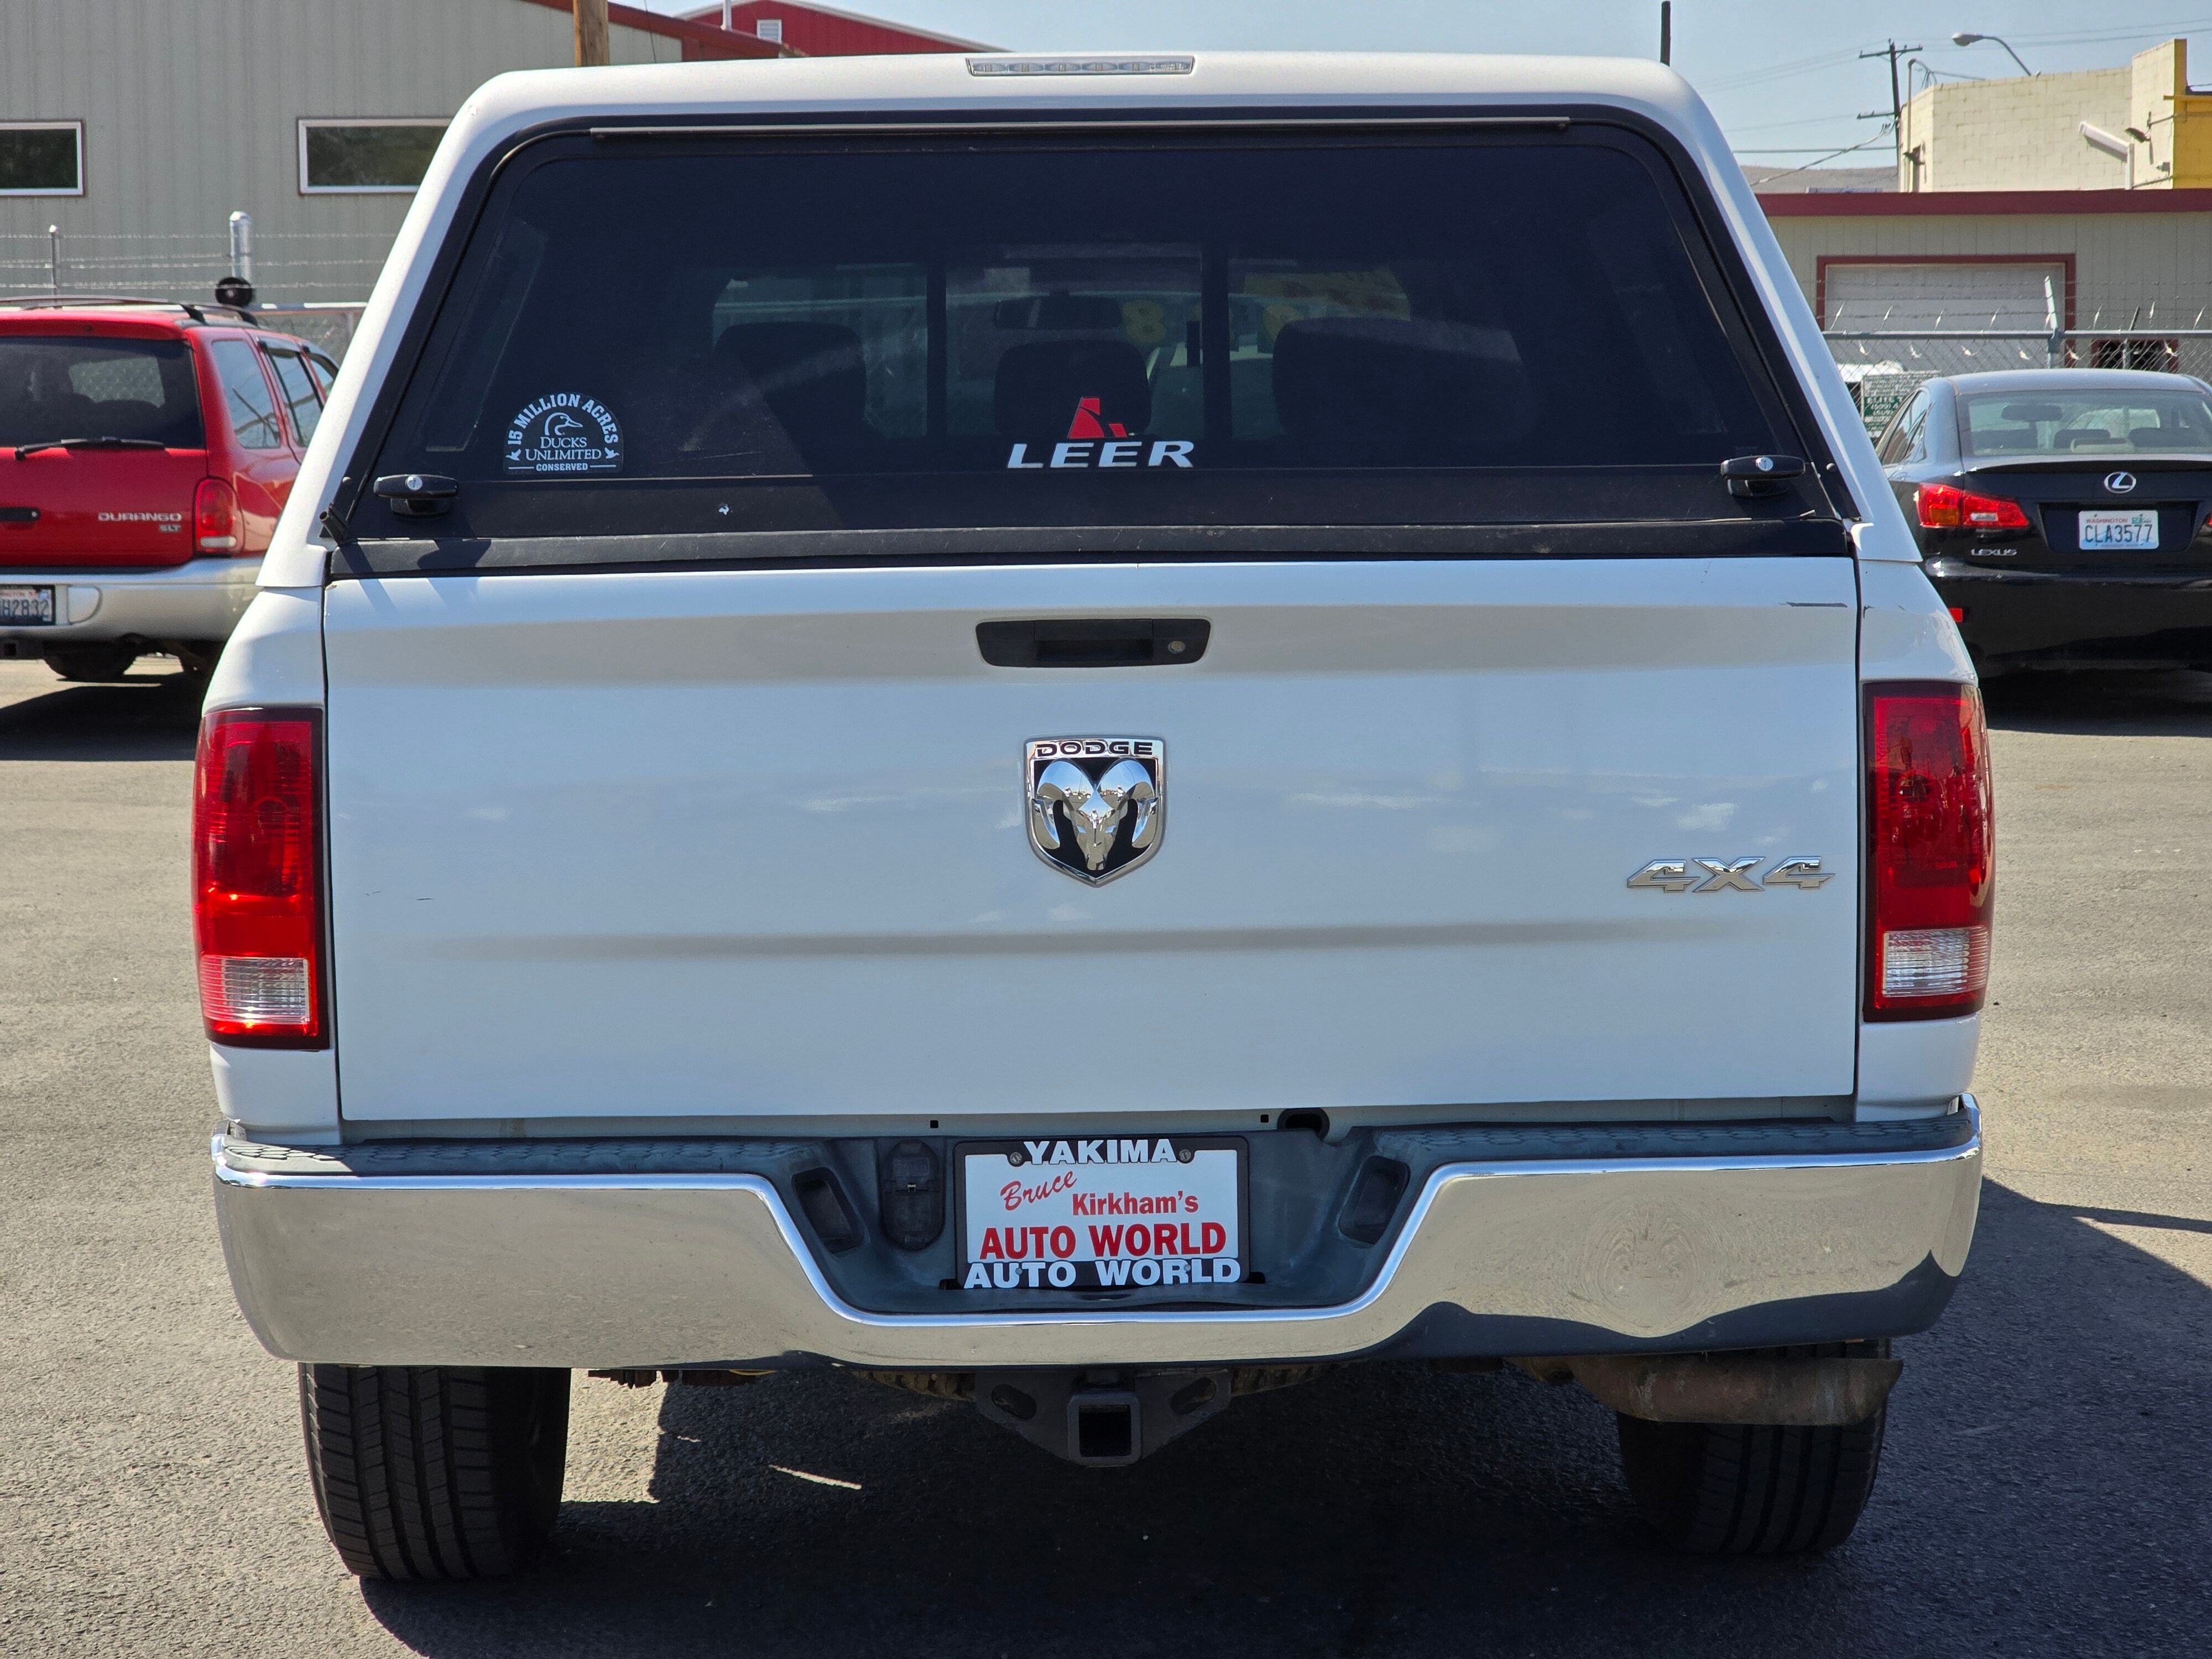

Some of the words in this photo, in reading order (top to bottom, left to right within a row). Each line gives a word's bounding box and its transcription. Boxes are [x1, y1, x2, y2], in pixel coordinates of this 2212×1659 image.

[514, 393, 581, 429] MILLION
[582, 399, 618, 444] ACRES
[508, 430, 523, 445] 15
[540, 437, 587, 448] DUCKS
[525, 448, 602, 461] UNLIMITED
[1008, 441, 1194, 469] LEER
[536, 463, 588, 472] CONSERVED
[97, 512, 182, 521] DURANGO
[2085, 524, 2153, 543] CLA3577
[0, 599, 49, 618] H2832
[1036, 741, 1153, 757] DODGE
[1626, 856, 1836, 893] 4X4
[1023, 1138, 1177, 1165] YAKIMA
[1000, 1171, 1077, 1211] Bruce
[1072, 1191, 1199, 1215] Kirkham's
[979, 1225, 1076, 1260] AUTO
[1088, 1222, 1227, 1258] WORLD
[963, 1261, 1076, 1289] AUTO
[1094, 1258, 1241, 1287] WORLD
